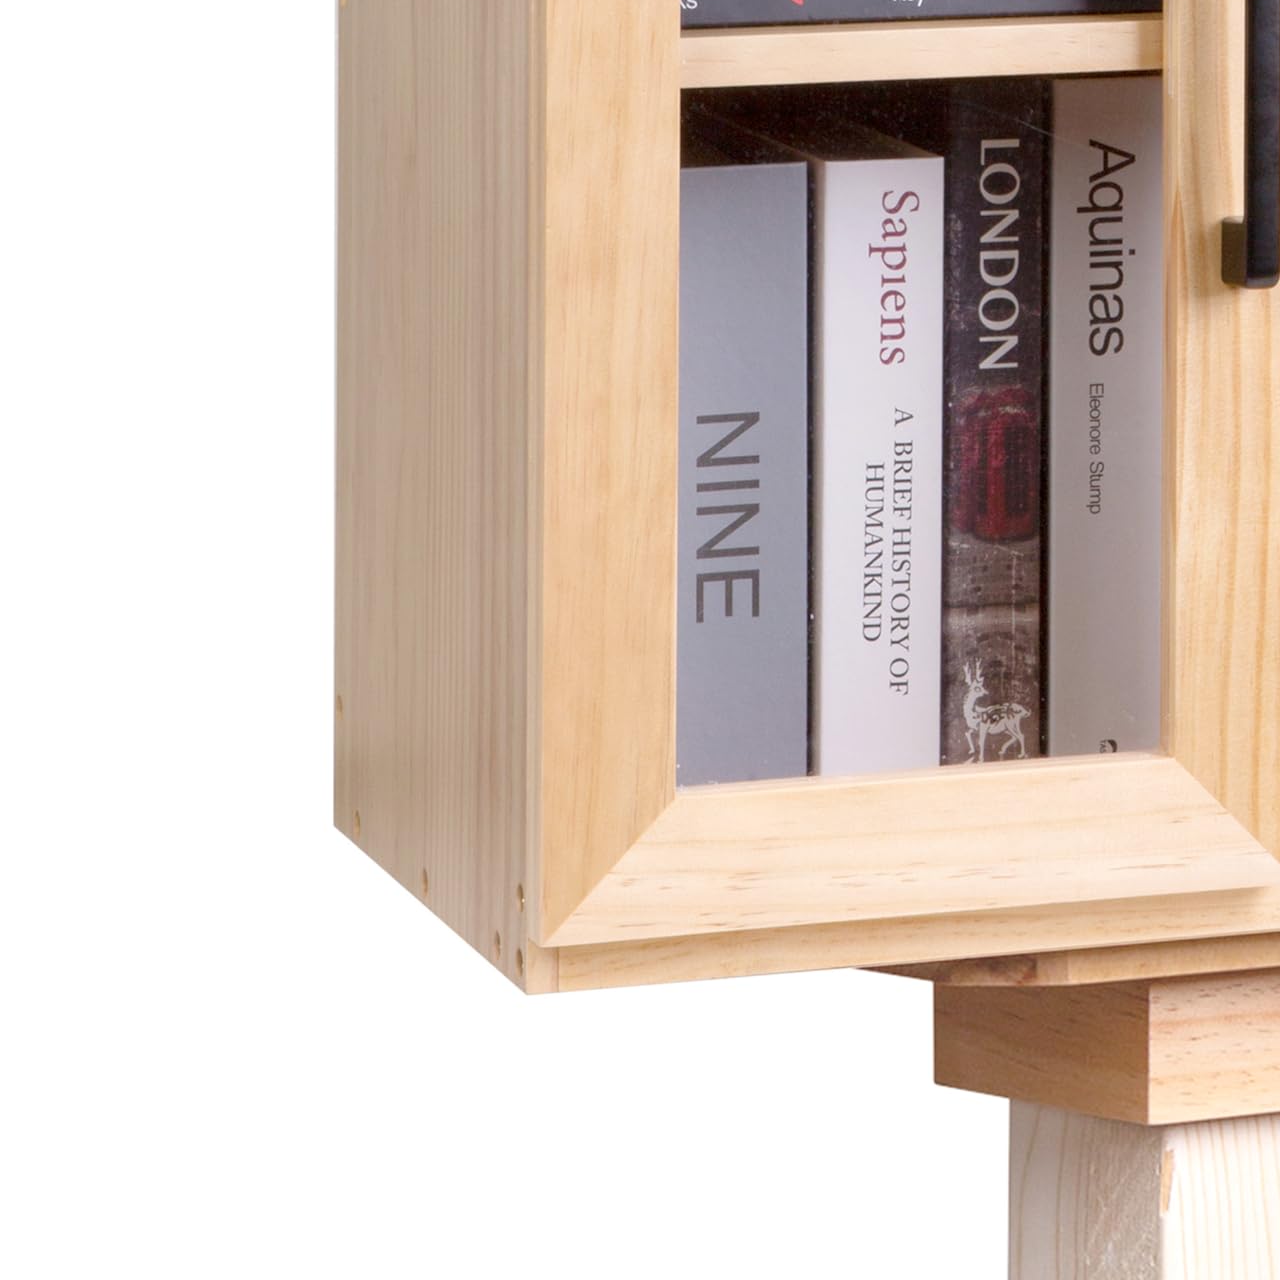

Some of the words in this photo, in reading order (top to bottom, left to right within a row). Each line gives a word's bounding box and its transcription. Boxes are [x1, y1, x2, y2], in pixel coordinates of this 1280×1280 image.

[868, 190, 920, 367] Sapiens
[978, 139, 1021, 371] LONDON
[1076, 138, 1137, 357] Aquinas
[894, 407, 915, 427] A
[1088, 382, 1105, 455] Eleonore
[696, 410, 761, 624] NINE
[892, 440, 914, 520] BRIEF
[1088, 461, 1105, 514] Stump
[862, 463, 885, 643] HUMANKIND
[890, 527, 912, 652] HISTORY
[889, 658, 911, 696] OF
